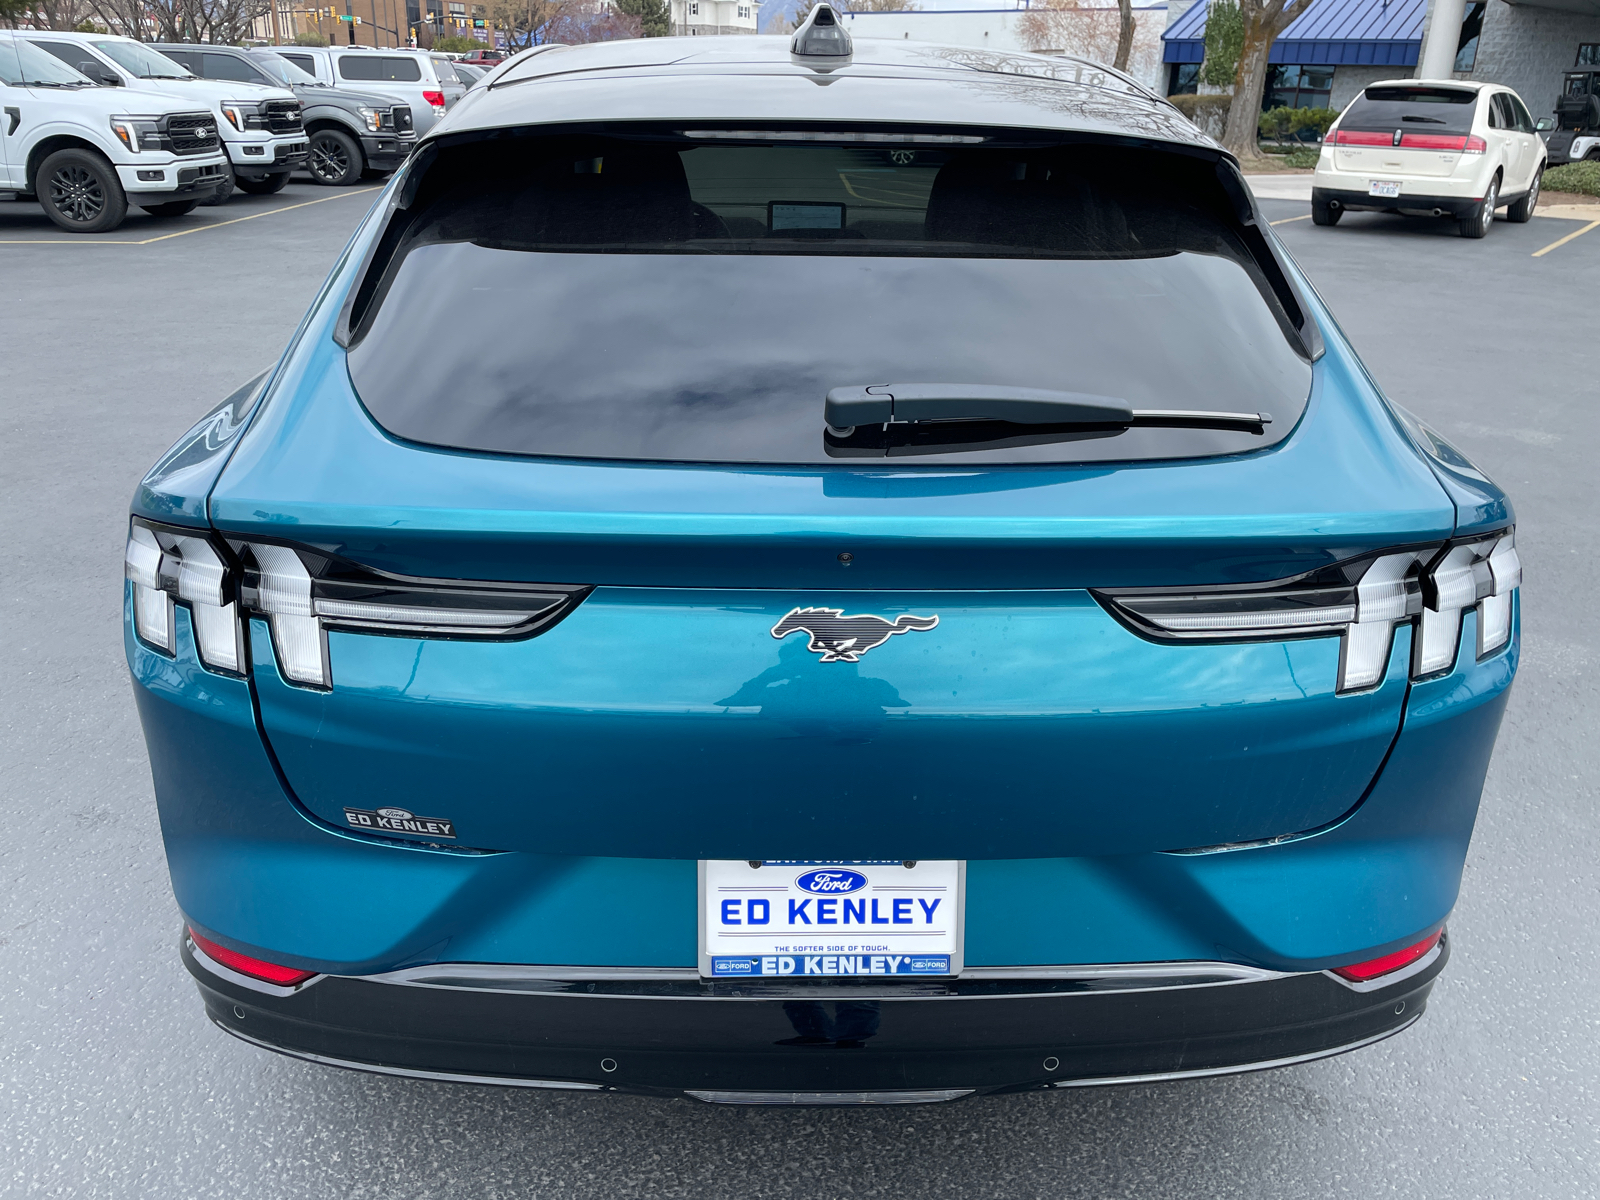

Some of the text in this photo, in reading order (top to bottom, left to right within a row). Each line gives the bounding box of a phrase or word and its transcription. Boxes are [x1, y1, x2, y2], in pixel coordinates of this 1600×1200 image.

[345, 812, 451, 834] ED KENLEY
[384, 809, 406, 818] Ford
[809, 872, 853, 891] Ford
[721, 898, 942, 925] ED KENLEY
[761, 956, 902, 975] ED KENLEY
